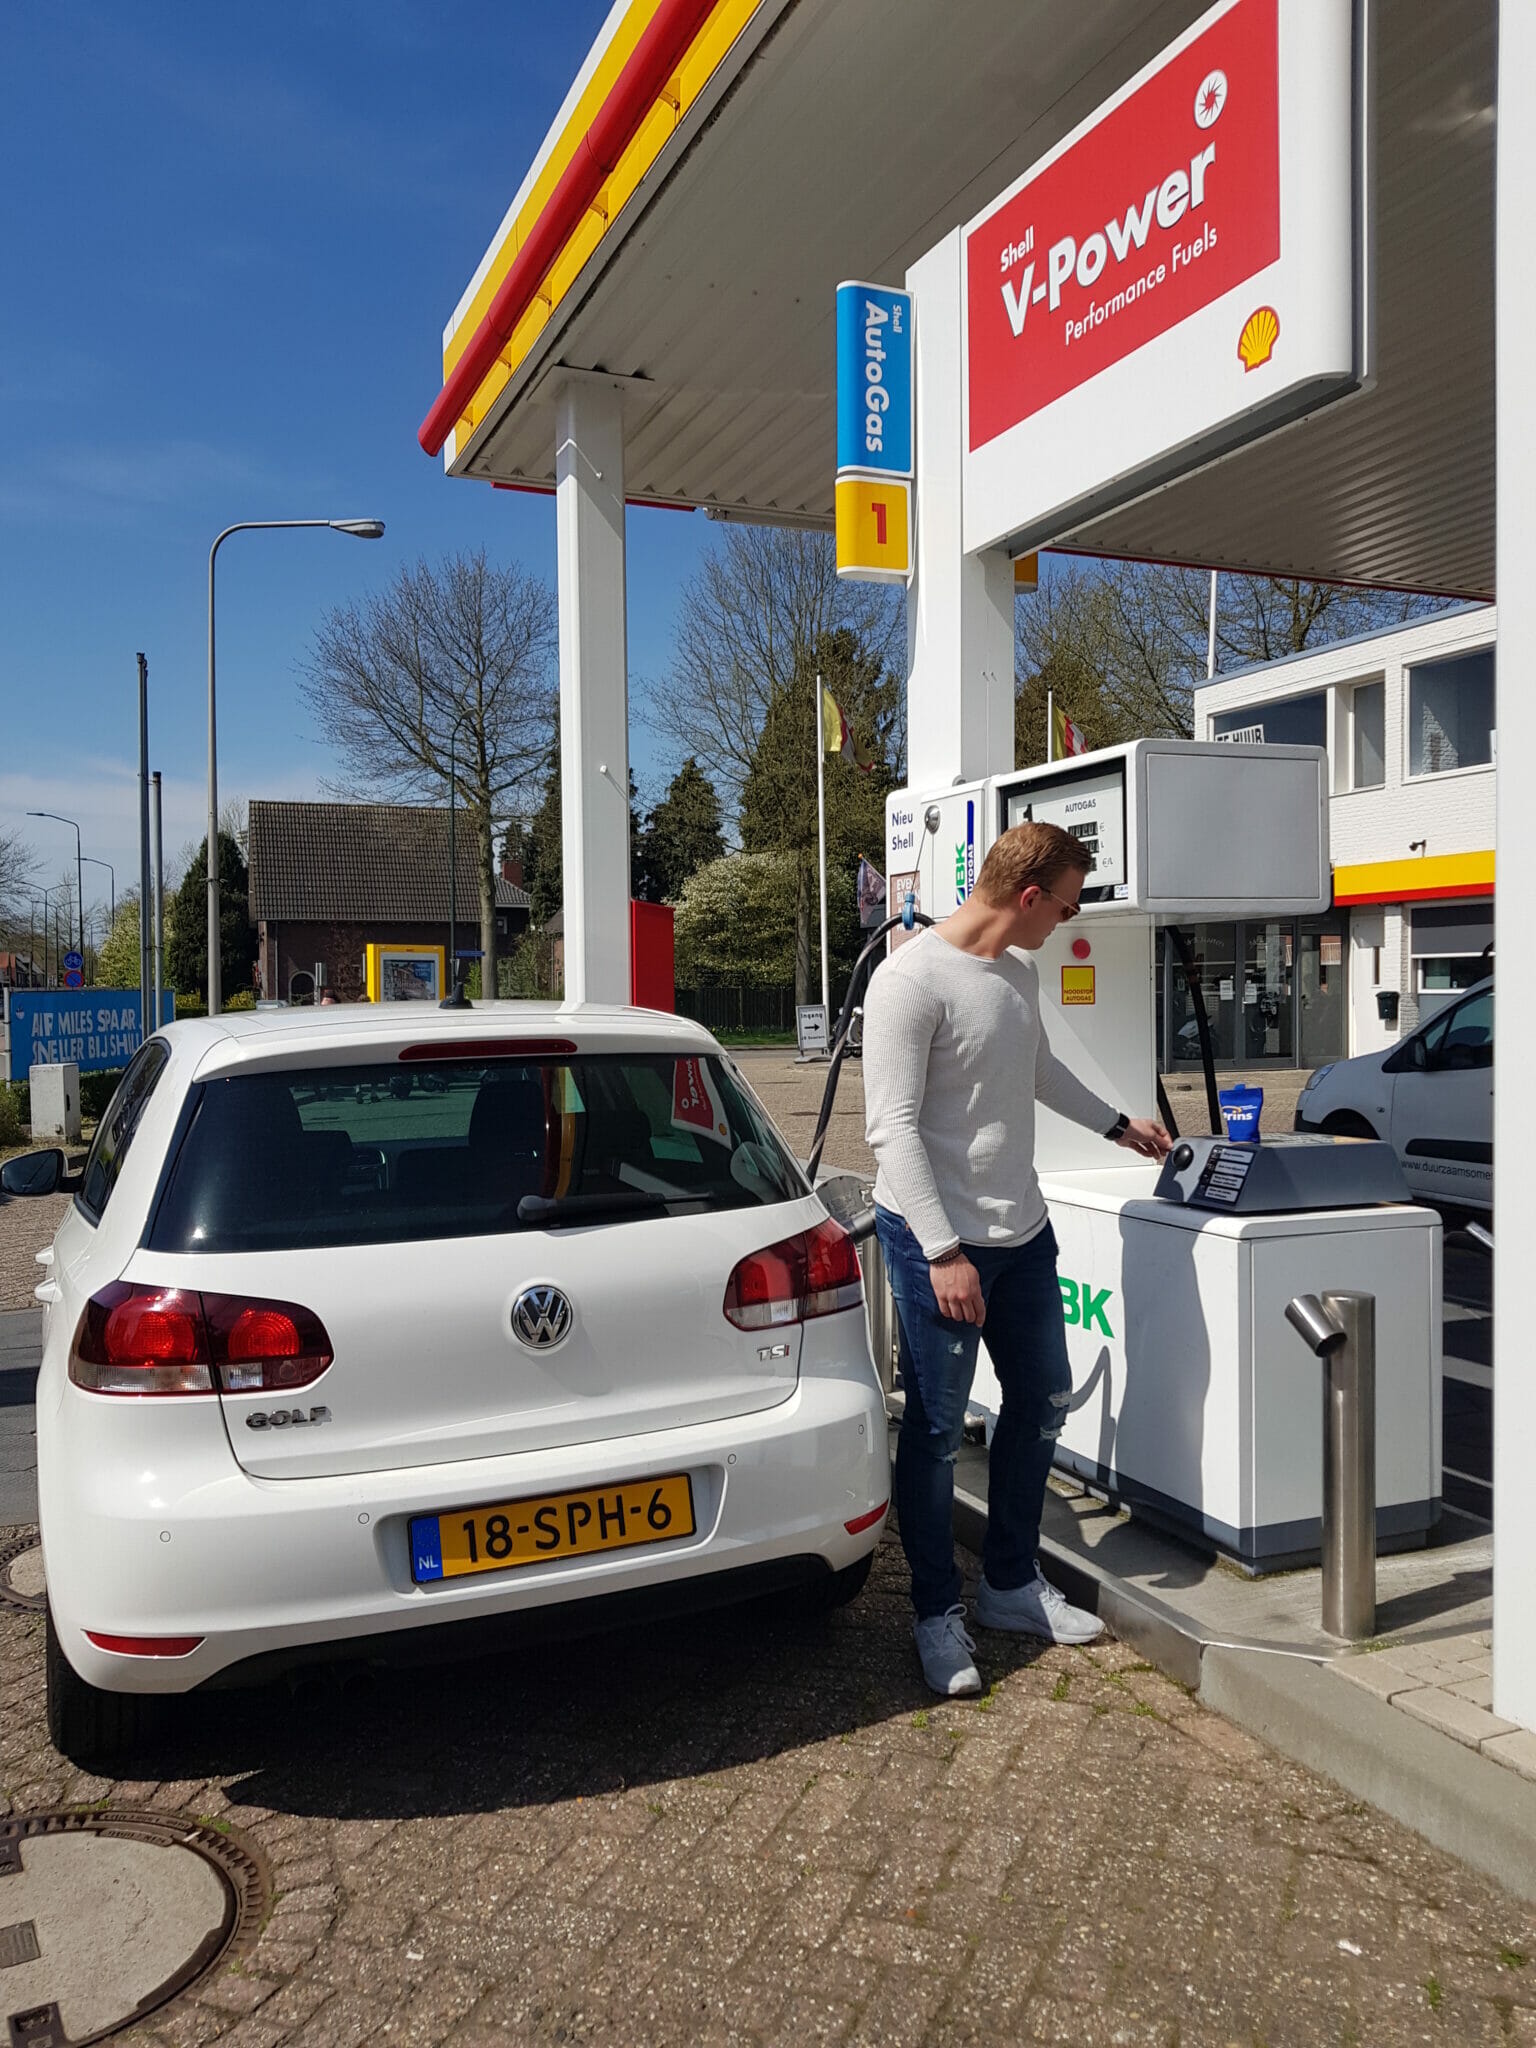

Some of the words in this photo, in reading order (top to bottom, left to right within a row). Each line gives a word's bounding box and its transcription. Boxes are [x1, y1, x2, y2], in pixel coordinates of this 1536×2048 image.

[1001, 140, 1216, 339] V-Power
[1001, 225, 1035, 272] Shell
[1066, 263, 1166, 346] Performance
[1172, 221, 1218, 273] Fuels
[893, 303, 902, 334] Shell
[865, 299, 889, 452] AutoGas
[871, 502, 887, 544] 1
[891, 810, 913, 827] Nieu
[1065, 798, 1097, 814] AUTOGAS
[892, 831, 914, 850] Shell
[967, 844, 975, 897] UTOGAS
[58, 1009, 93, 1036] MILES
[97, 1008, 136, 1033] SPAAR
[88, 1035, 109, 1059] BIJ
[757, 1344, 790, 1361] TSI
[245, 1405, 330, 1429] GOLF
[462, 1487, 672, 1563] 18-SPH-6
[418, 1555, 440, 1571] NL
